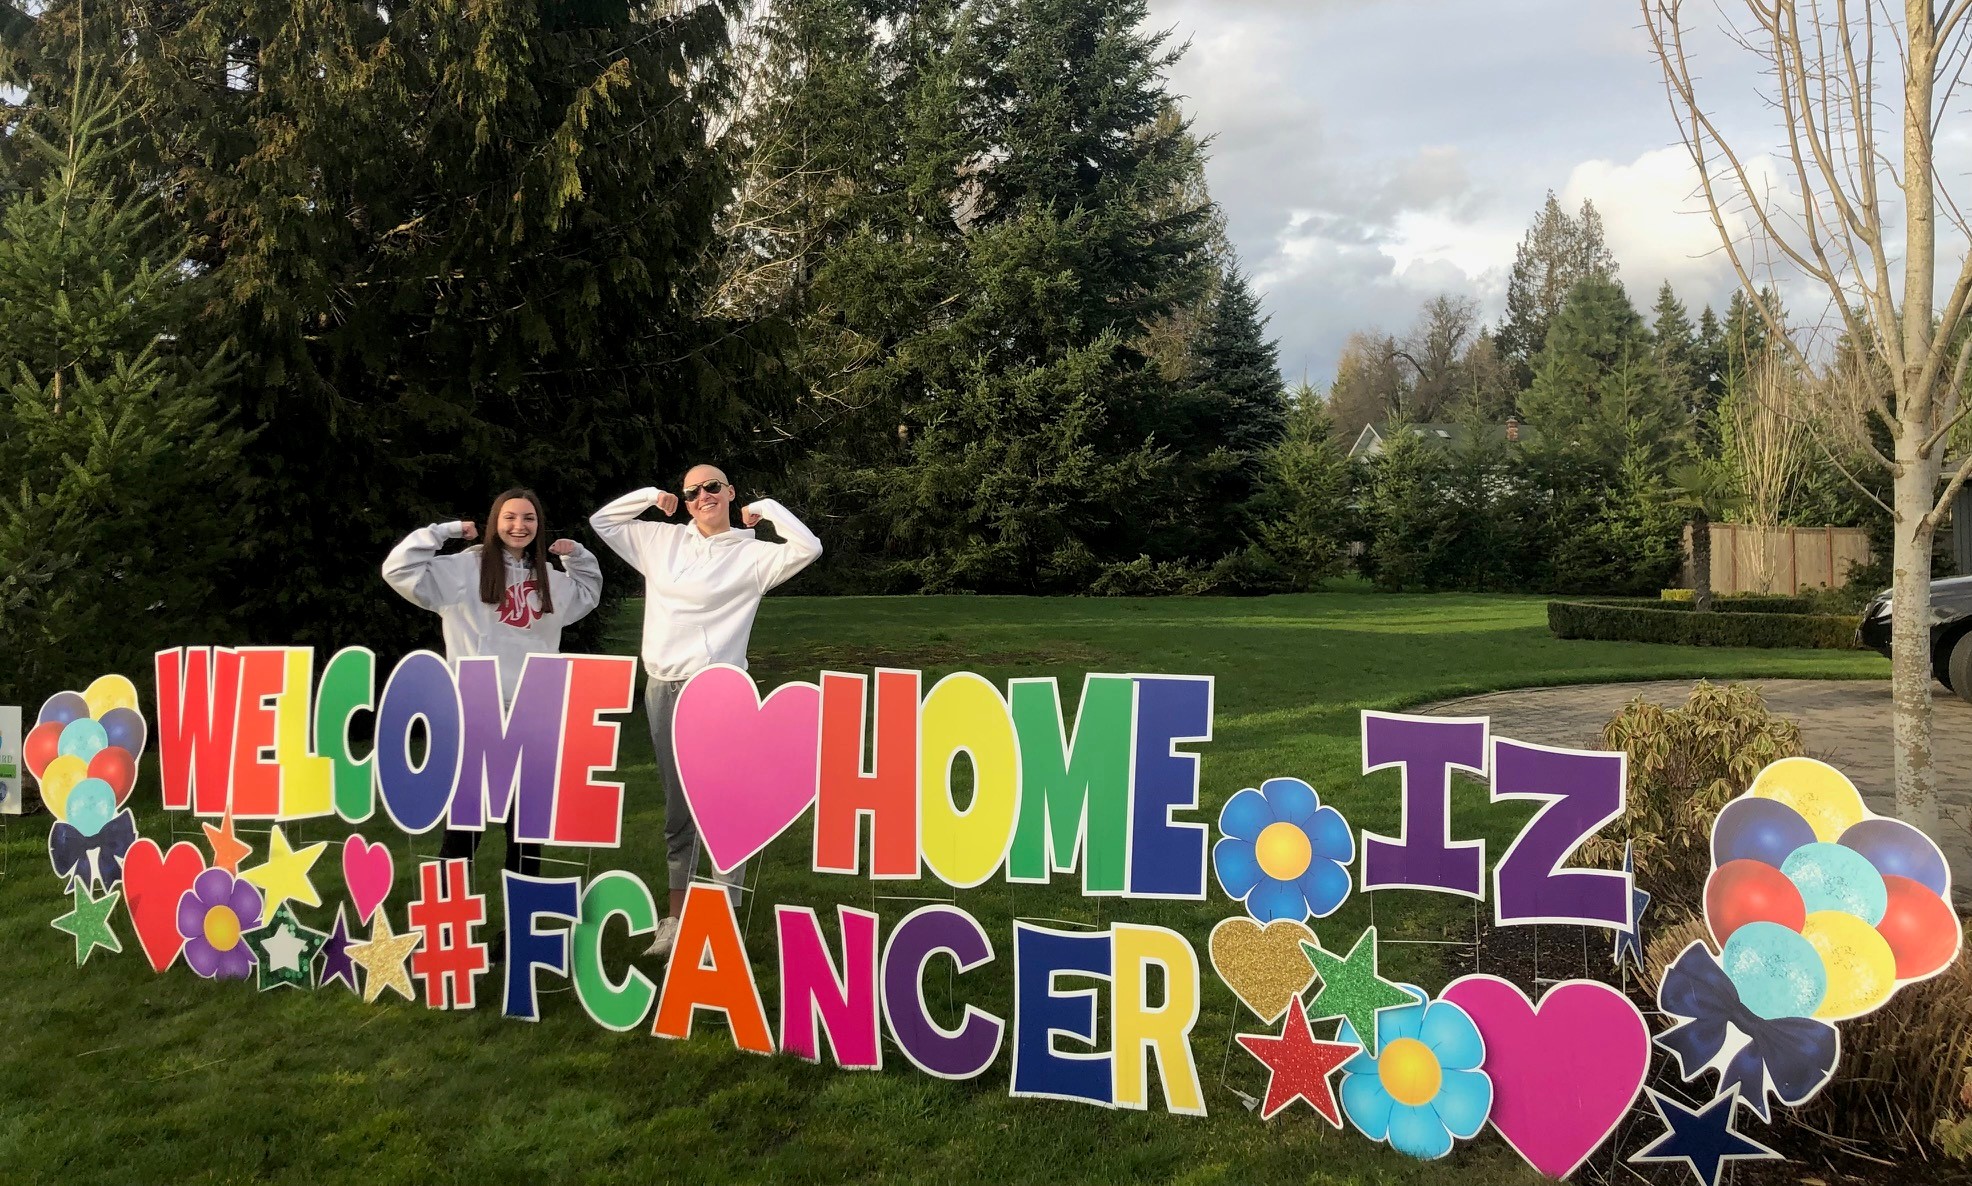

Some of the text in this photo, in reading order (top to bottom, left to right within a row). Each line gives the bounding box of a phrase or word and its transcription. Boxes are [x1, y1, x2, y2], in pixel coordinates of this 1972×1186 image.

[156, 647, 1634, 926] WELCOME HOME IZ
[408, 857, 1208, 1117] #FCANCER
